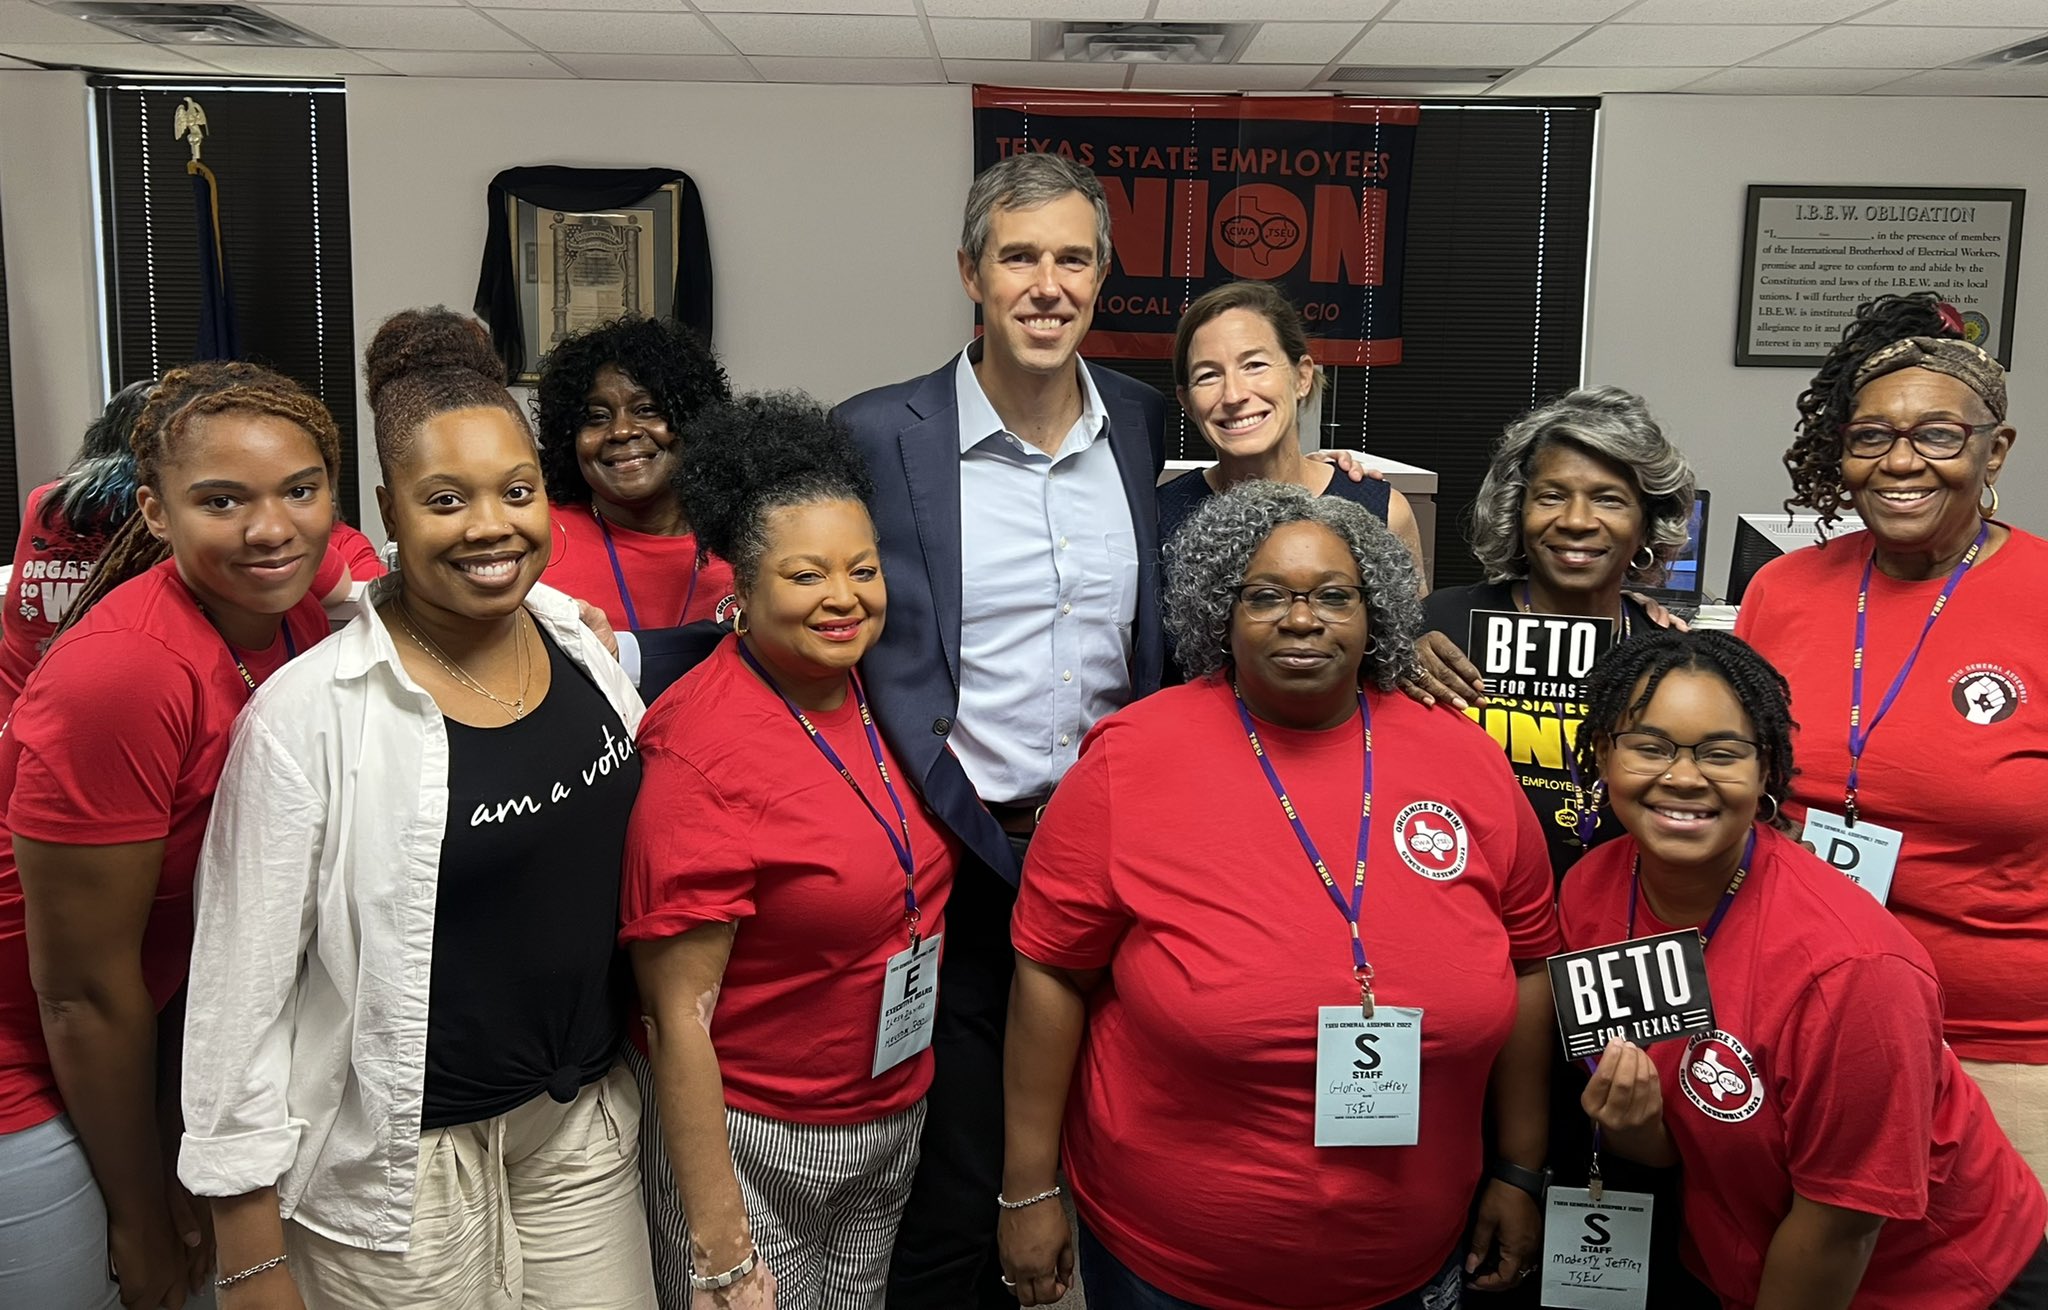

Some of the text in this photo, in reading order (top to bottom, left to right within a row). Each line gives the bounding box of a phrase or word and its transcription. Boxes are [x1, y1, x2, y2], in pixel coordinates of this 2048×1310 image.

[1107, 146, 1199, 171] STATE
[1211, 147, 1391, 180] EMPLOYEES
[1795, 204, 1976, 223] I.B.E.W. OBLIGATION
[1097, 176, 1388, 287] NION
[1229, 226, 1256, 237] CWA
[1267, 227, 1295, 239] TSEU
[1877, 232, 1887, 240] in
[1889, 231, 1904, 240] the
[1907, 233, 1946, 242] presence
[1948, 232, 1959, 240] of
[1961, 232, 2001, 241] members
[1762, 245, 1772, 254] of
[1774, 245, 1788, 254] the
[1791, 245, 1847, 255] International
[1849, 246, 1904, 255] Brotherhood
[1906, 247, 1916, 256] of
[1918, 247, 1958, 257] Electrical
[1761, 261, 1984, 274] promise and agree to conform to and abide by the
[1760, 276, 1817, 285] Constitution
[1819, 277, 1836, 286] and
[1839, 277, 1859, 286] laws
[1862, 278, 1872, 287] of
[1874, 278, 1889, 287] the
[1933, 279, 1950, 288] and
[1953, 279, 1964, 288] its
[1967, 279, 1988, 288] local
[1097, 295, 1172, 316] LOCAL
[1296, 302, 1341, 322] -CIO
[1803, 292, 1820, 301] will
[1822, 292, 1855, 302] further
[1857, 293, 1872, 302] the
[1942, 295, 1961, 304] hich
[1964, 295, 1979, 304] the
[1800, 308, 1807, 317] is
[1756, 322, 1800, 333] allegiance
[1803, 324, 1812, 333] to
[1814, 324, 1822, 333] it
[1824, 324, 1841, 333] and
[1755, 339, 1790, 348] interest
[1792, 339, 1801, 348] in
[1804, 341, 1820, 349] any
[1962, 543, 1979, 564] TSEU
[1857, 591, 1866, 613] TSEU
[1930, 594, 1947, 617] TSEU
[1486, 616, 1597, 679] BETO
[1853, 647, 1863, 669] TSEU
[237, 662, 256, 688] TSEU
[1965, 663, 2003, 672] GENERAL
[2004, 669, 2028, 704] ASSEMBLY
[1500, 679, 1576, 699] FOR TEXAS
[859, 703, 872, 726] TSEU
[1850, 704, 1860, 727] TSEU
[1249, 731, 1264, 757] TSEU
[878, 761, 890, 784] TSEU
[1522, 776, 1575, 792] EMPLOYE
[470, 795, 541, 827] am
[551, 781, 571, 803] a
[1280, 793, 1297, 820] TSEU
[1362, 792, 1372, 818] TSEU
[1395, 802, 1463, 833] ORGANIZE TO WIN!
[1401, 850, 1430, 876] GENERAL
[1826, 837, 1861, 871] D
[1315, 859, 1334, 887] TSEU
[1354, 860, 1366, 887] TSEU
[1726, 868, 1747, 896] TSEU
[904, 963, 921, 1000] E
[1566, 940, 1691, 1026] BETO
[915, 986, 933, 1001] BOARD
[1597, 1014, 1681, 1047] FOR TEXAS
[1353, 1033, 1382, 1071] S
[1688, 1030, 1760, 1079] ORGANIZE TO WIN!
[1352, 1070, 1384, 1080] STAFF
[1694, 1066, 1714, 1078] CWA
[1722, 1077, 1744, 1090] TSEU
[1329, 1079, 1408, 1095] Gloria Jeffrey
[1681, 1068, 1761, 1120] GENERAL ASSEMBLY 2022
[1581, 1213, 1611, 1246] S
[1580, 1245, 1613, 1255] STAFF
[1552, 1254, 1642, 1273] Modesty Jeffrey
